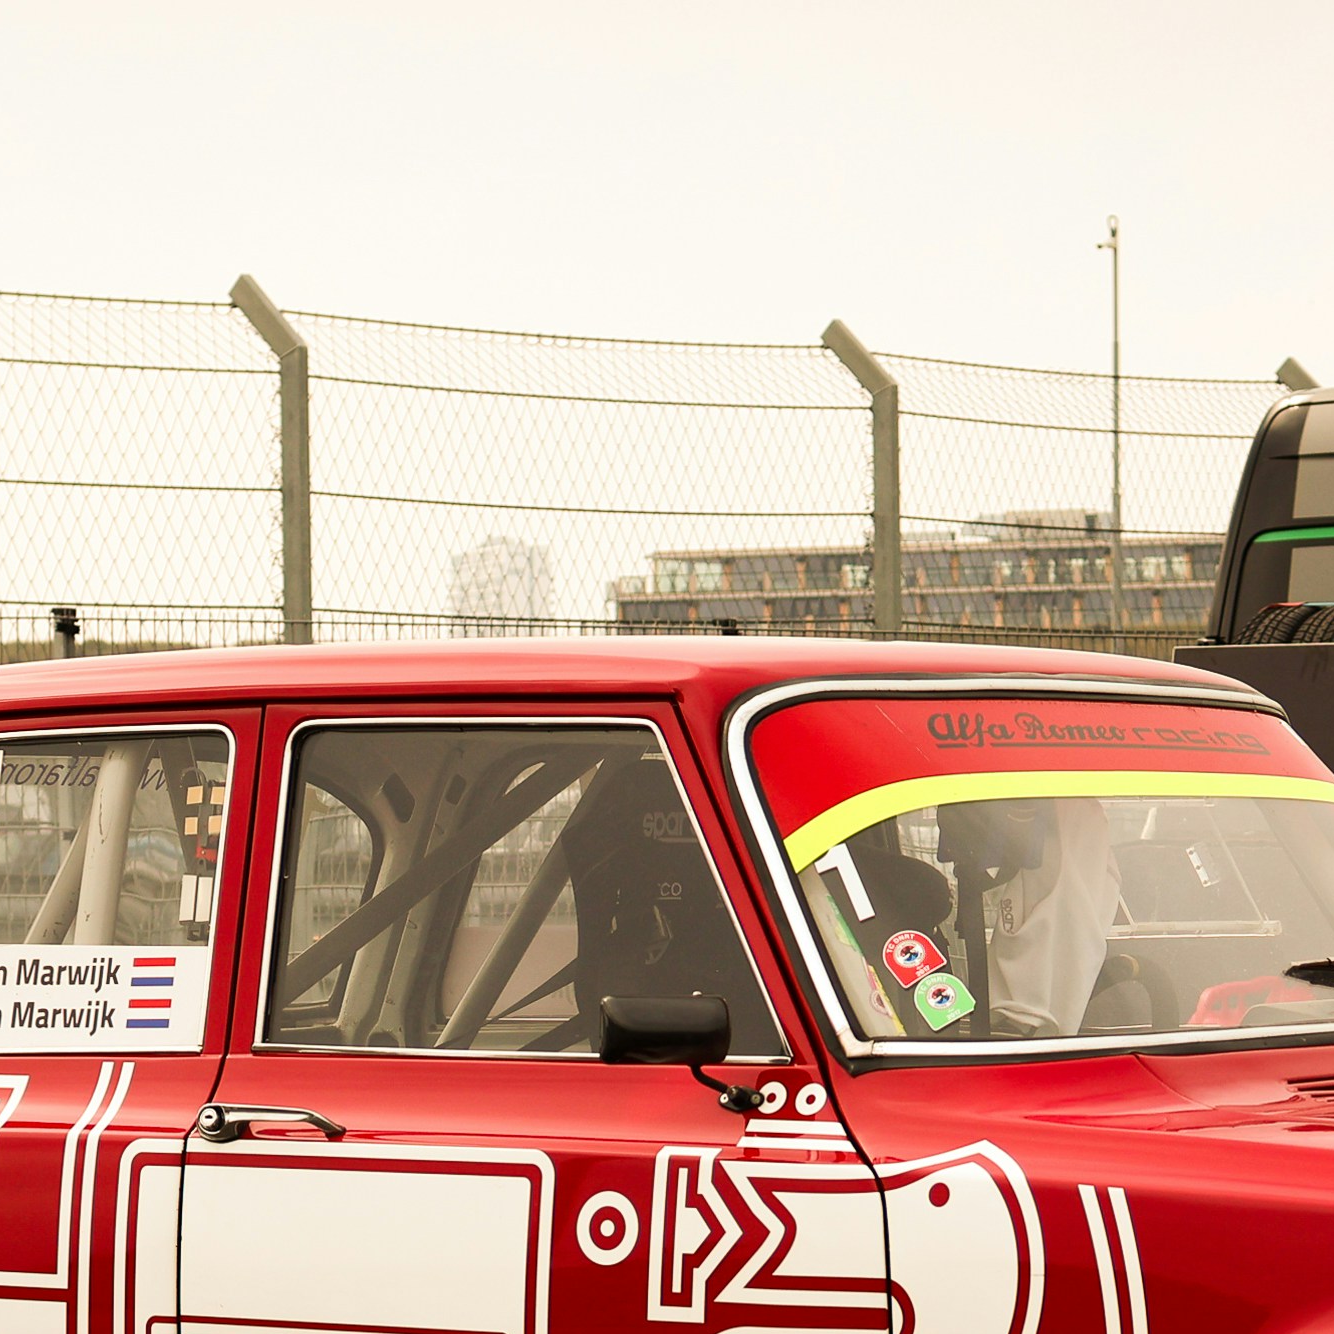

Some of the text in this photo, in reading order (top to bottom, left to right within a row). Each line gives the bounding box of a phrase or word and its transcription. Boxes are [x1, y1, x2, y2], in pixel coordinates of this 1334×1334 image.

[927, 712, 1269, 754] Alfa Romeo racing
[16, 957, 121, 993] Marwijk
[11, 1001, 116, 1036] Marwijk
